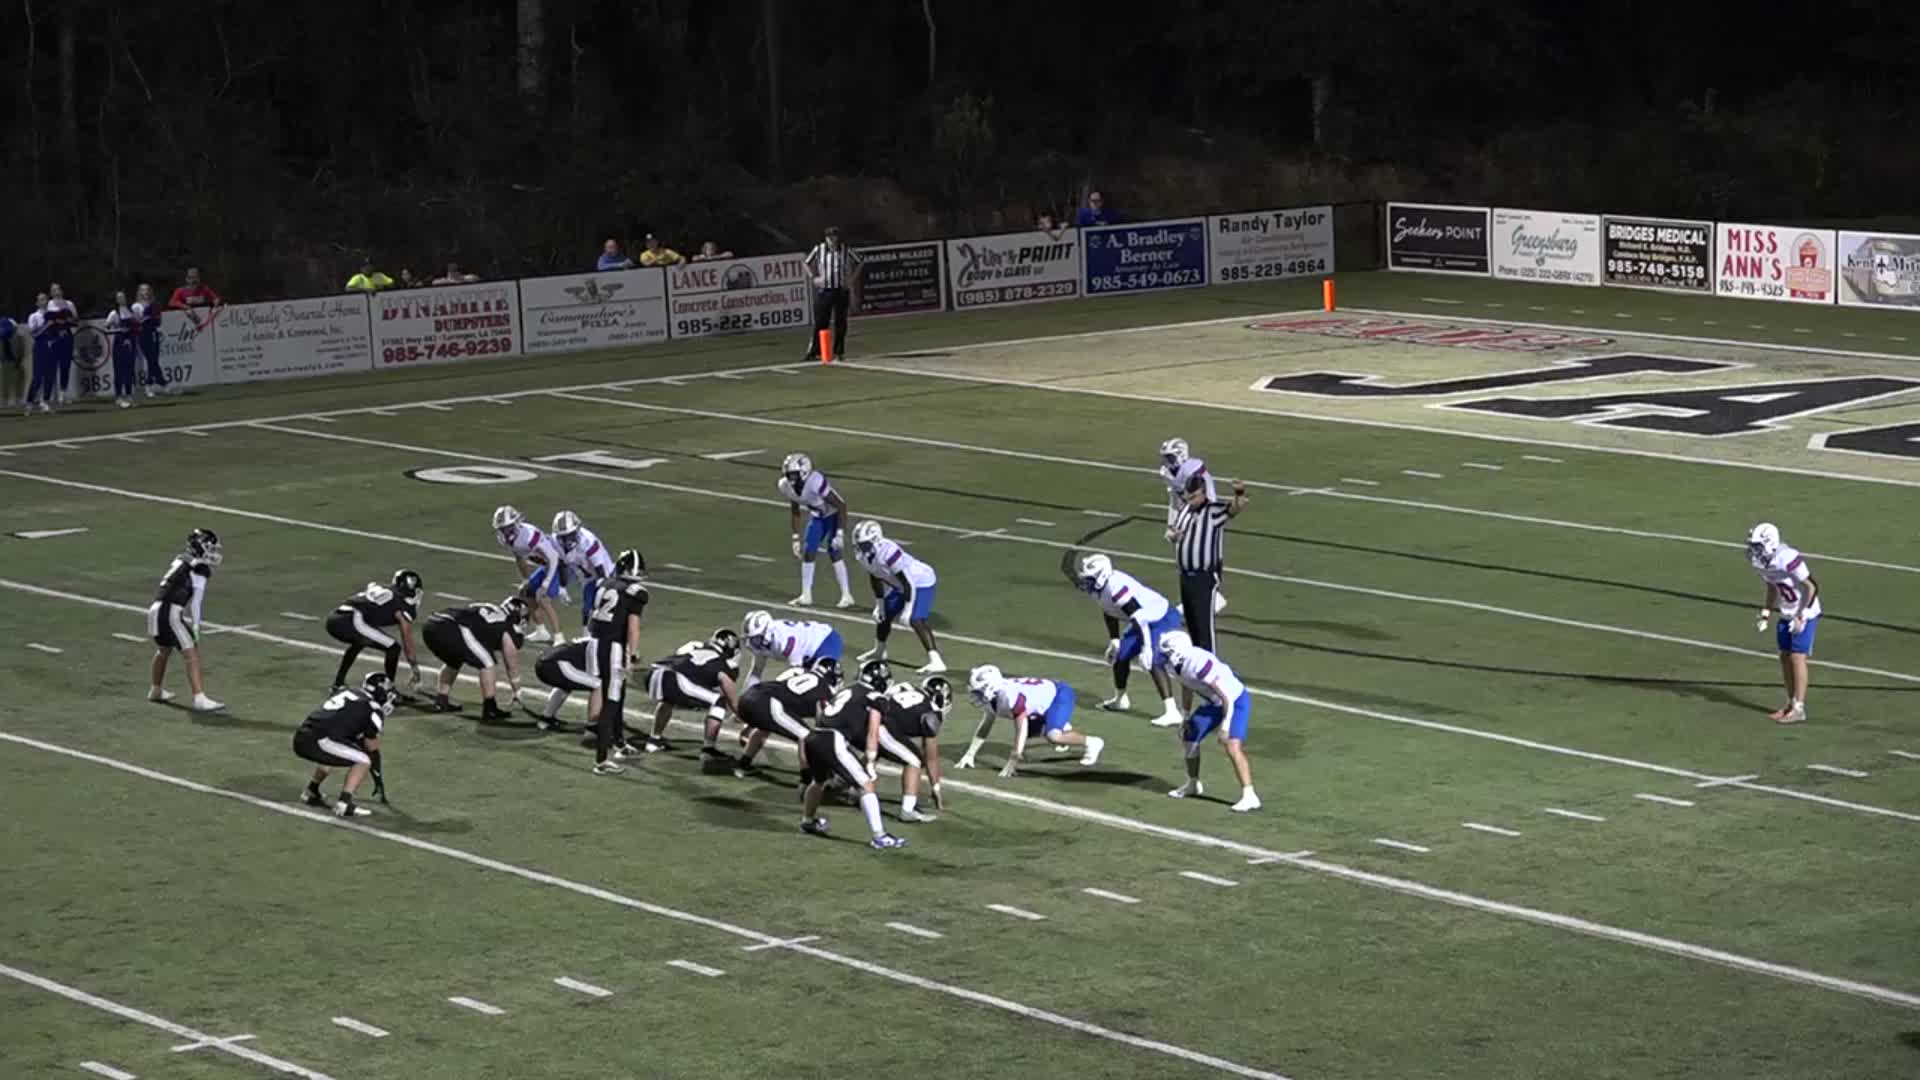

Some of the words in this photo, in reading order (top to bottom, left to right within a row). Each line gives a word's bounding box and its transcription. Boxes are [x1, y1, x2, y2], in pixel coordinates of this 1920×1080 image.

[1219, 215, 1268, 234] Randy
[1273, 211, 1325, 230] Taylor
[1446, 226, 1482, 239] POINT
[1106, 233, 1124, 248] A.
[1127, 229, 1184, 247] Bradley
[1609, 225, 1655, 242] BRIDGES
[1656, 228, 1706, 245] MEDICAL
[1727, 228, 1778, 254] MISS
[1019, 243, 1074, 264] PAINT
[1120, 248, 1174, 264] Berner
[1847, 254, 1875, 269] Kent
[673, 269, 717, 290] LANCE
[763, 261, 803, 281] PATTI
[1004, 266, 1032, 278] GLASS
[1220, 258, 1325, 280] 985-229-4964
[1607, 259, 1704, 279] 985-748-5158
[1722, 254, 1783, 281] ANN'S
[1091, 269, 1200, 291] 985-549-0673
[673, 299, 718, 314] Concrete
[720, 291, 788, 311] Construction,
[960, 289, 999, 305] (985)
[434, 314, 510, 332] DUMPSTERS
[383, 337, 512, 363] 985-746-9239
[591, 585, 620, 623] 12
